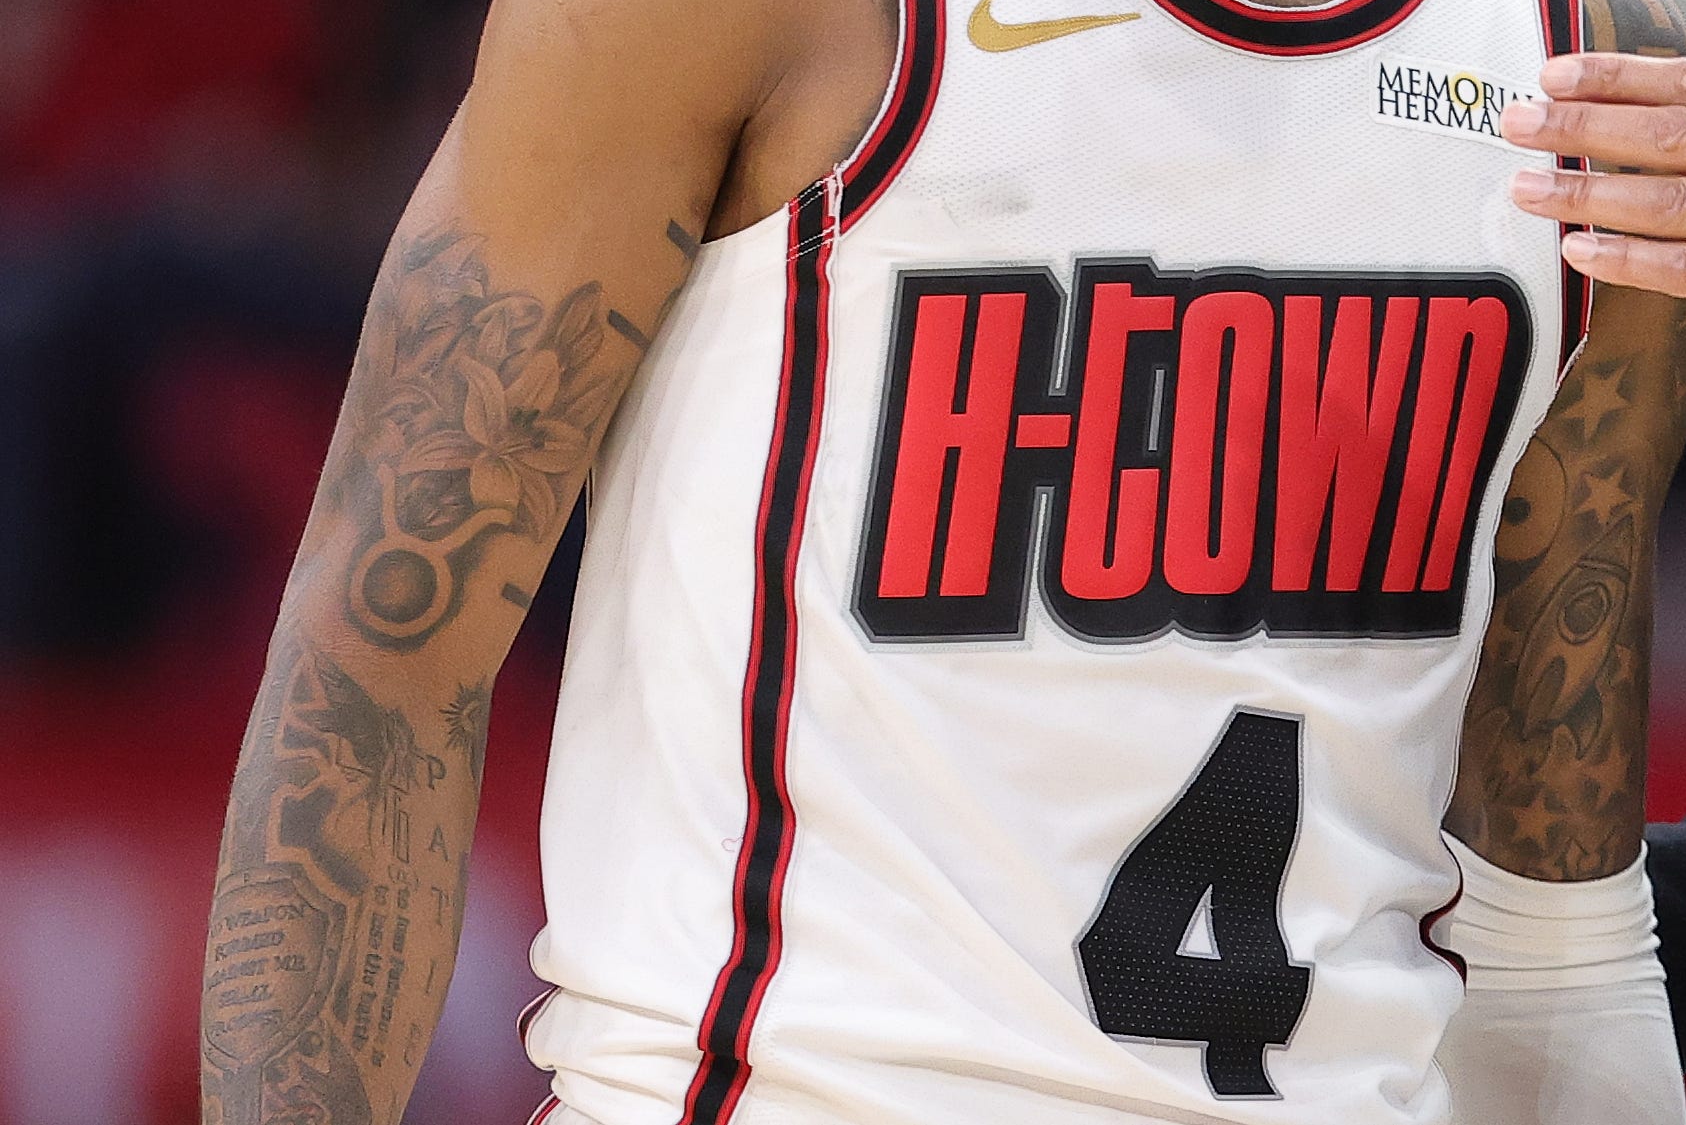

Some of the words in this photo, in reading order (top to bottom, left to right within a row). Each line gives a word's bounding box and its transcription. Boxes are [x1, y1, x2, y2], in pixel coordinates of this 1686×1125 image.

[1377, 61, 1534, 114] MEMORI
[1377, 87, 1503, 139] HERMA
[1071, 704, 1315, 1101] 4
